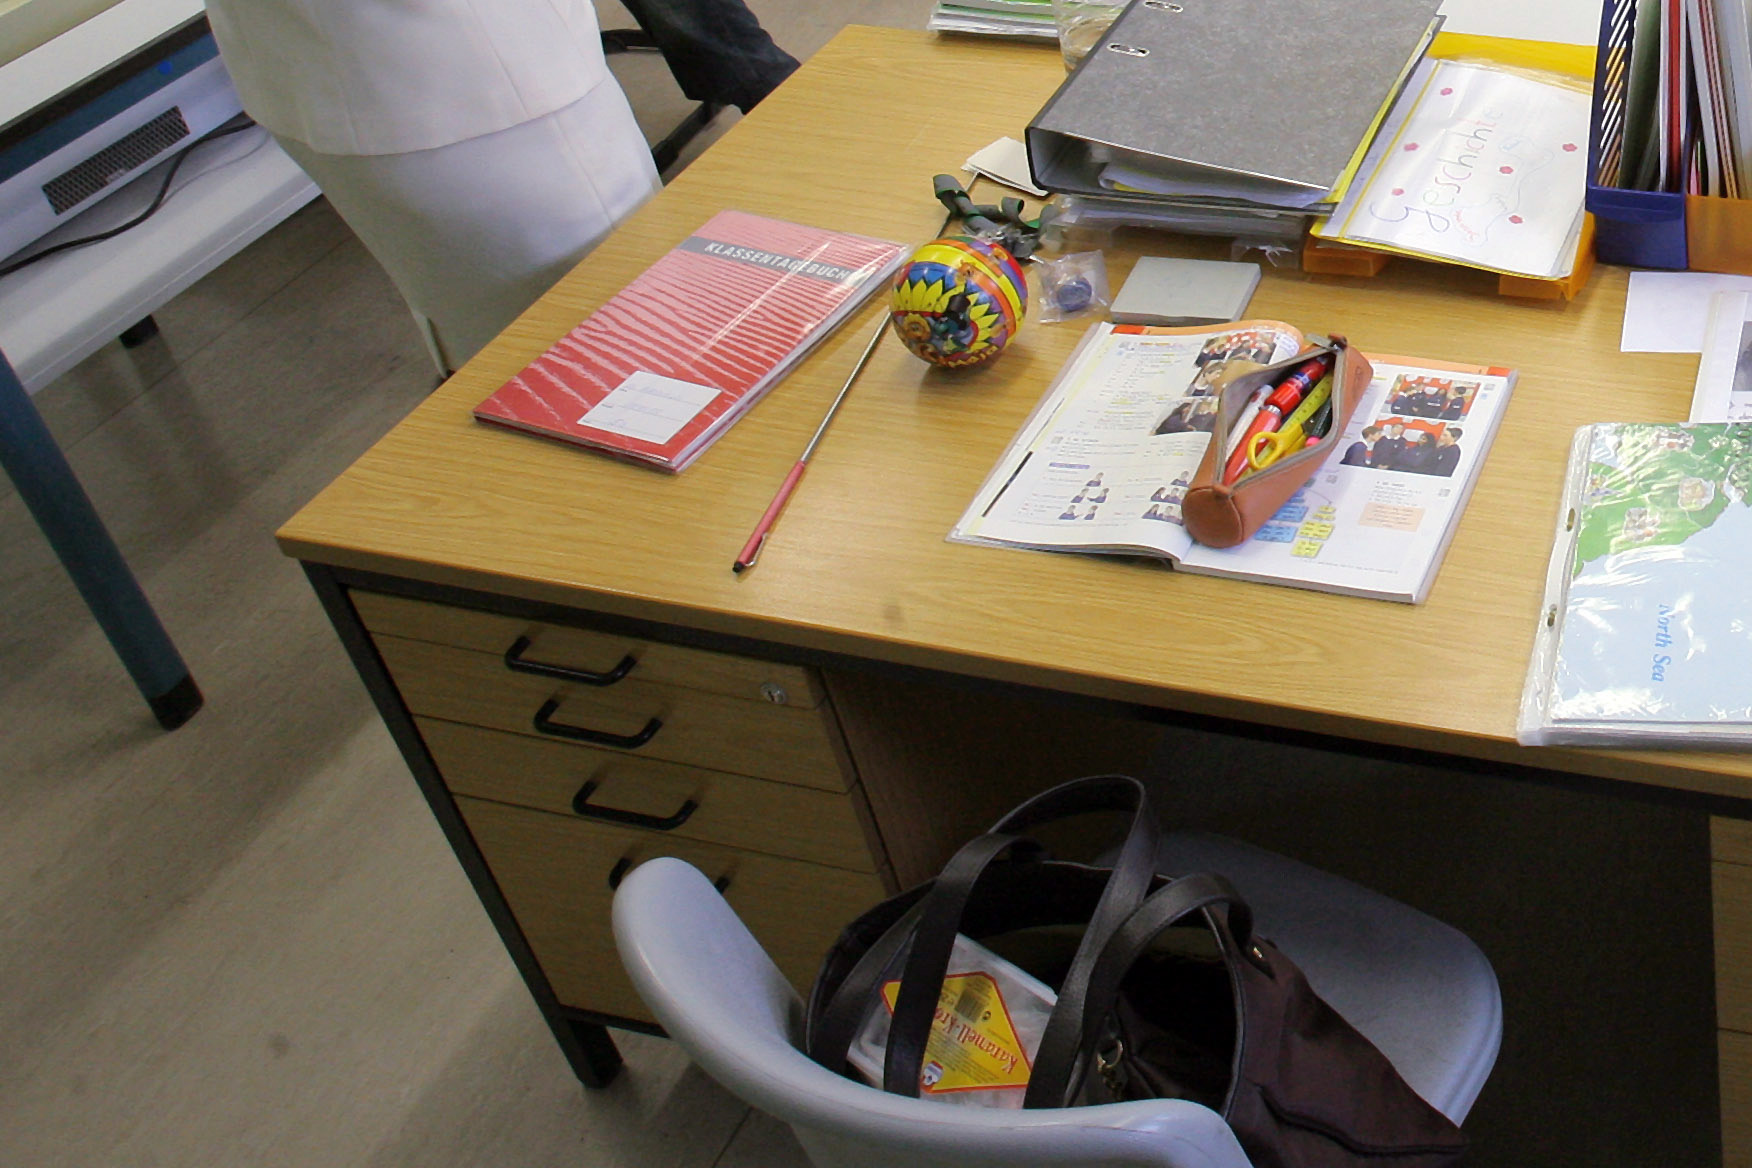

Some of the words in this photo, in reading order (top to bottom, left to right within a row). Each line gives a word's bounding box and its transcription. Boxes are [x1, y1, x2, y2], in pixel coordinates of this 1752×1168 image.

[704, 241, 850, 281] KLASSENTAGEBUCH
[1654, 603, 1676, 648] North
[1651, 653, 1672, 682] Sea
